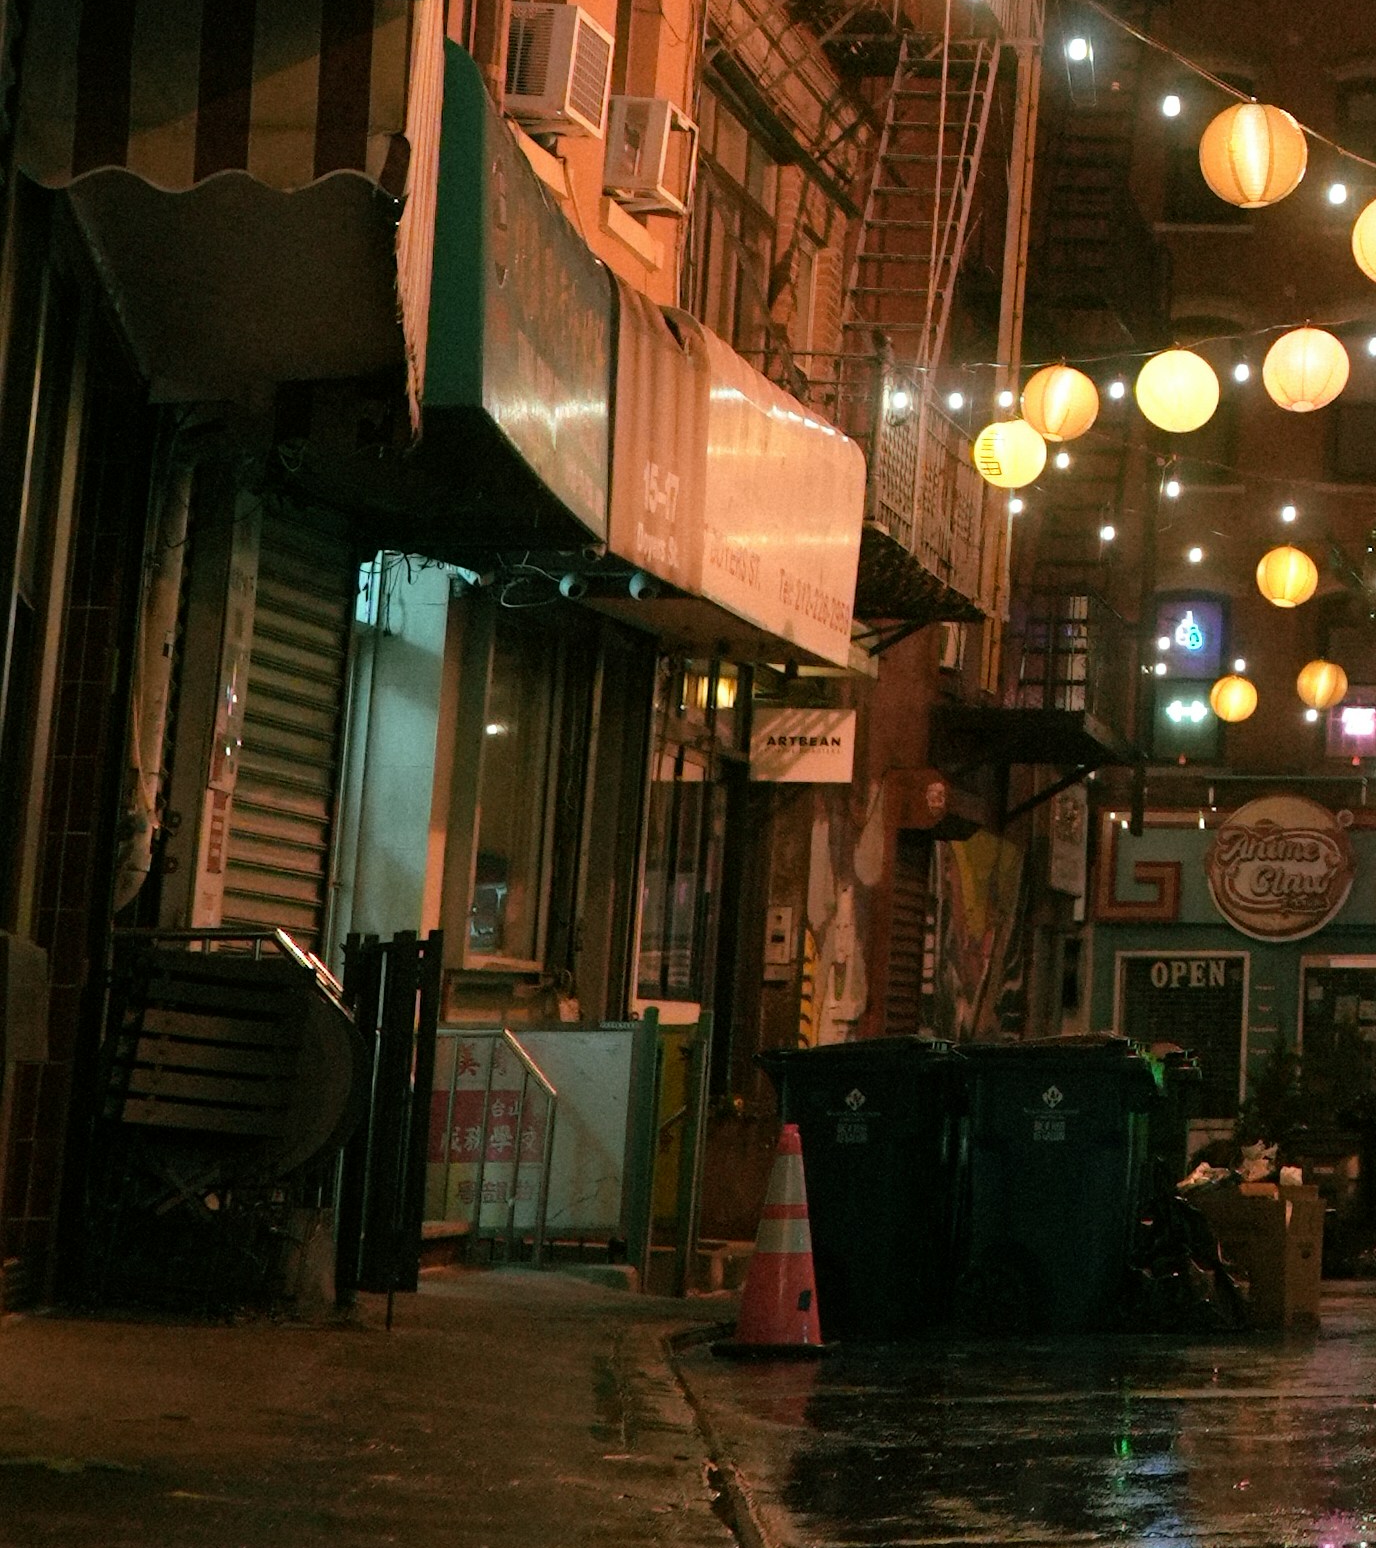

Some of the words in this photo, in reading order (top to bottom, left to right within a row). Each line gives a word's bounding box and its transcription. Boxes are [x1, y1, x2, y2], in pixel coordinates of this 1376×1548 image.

[766, 736, 842, 747] ARTBEAN
[1219, 827, 1321, 865] Anime
[1150, 960, 1227, 988] OPEN
